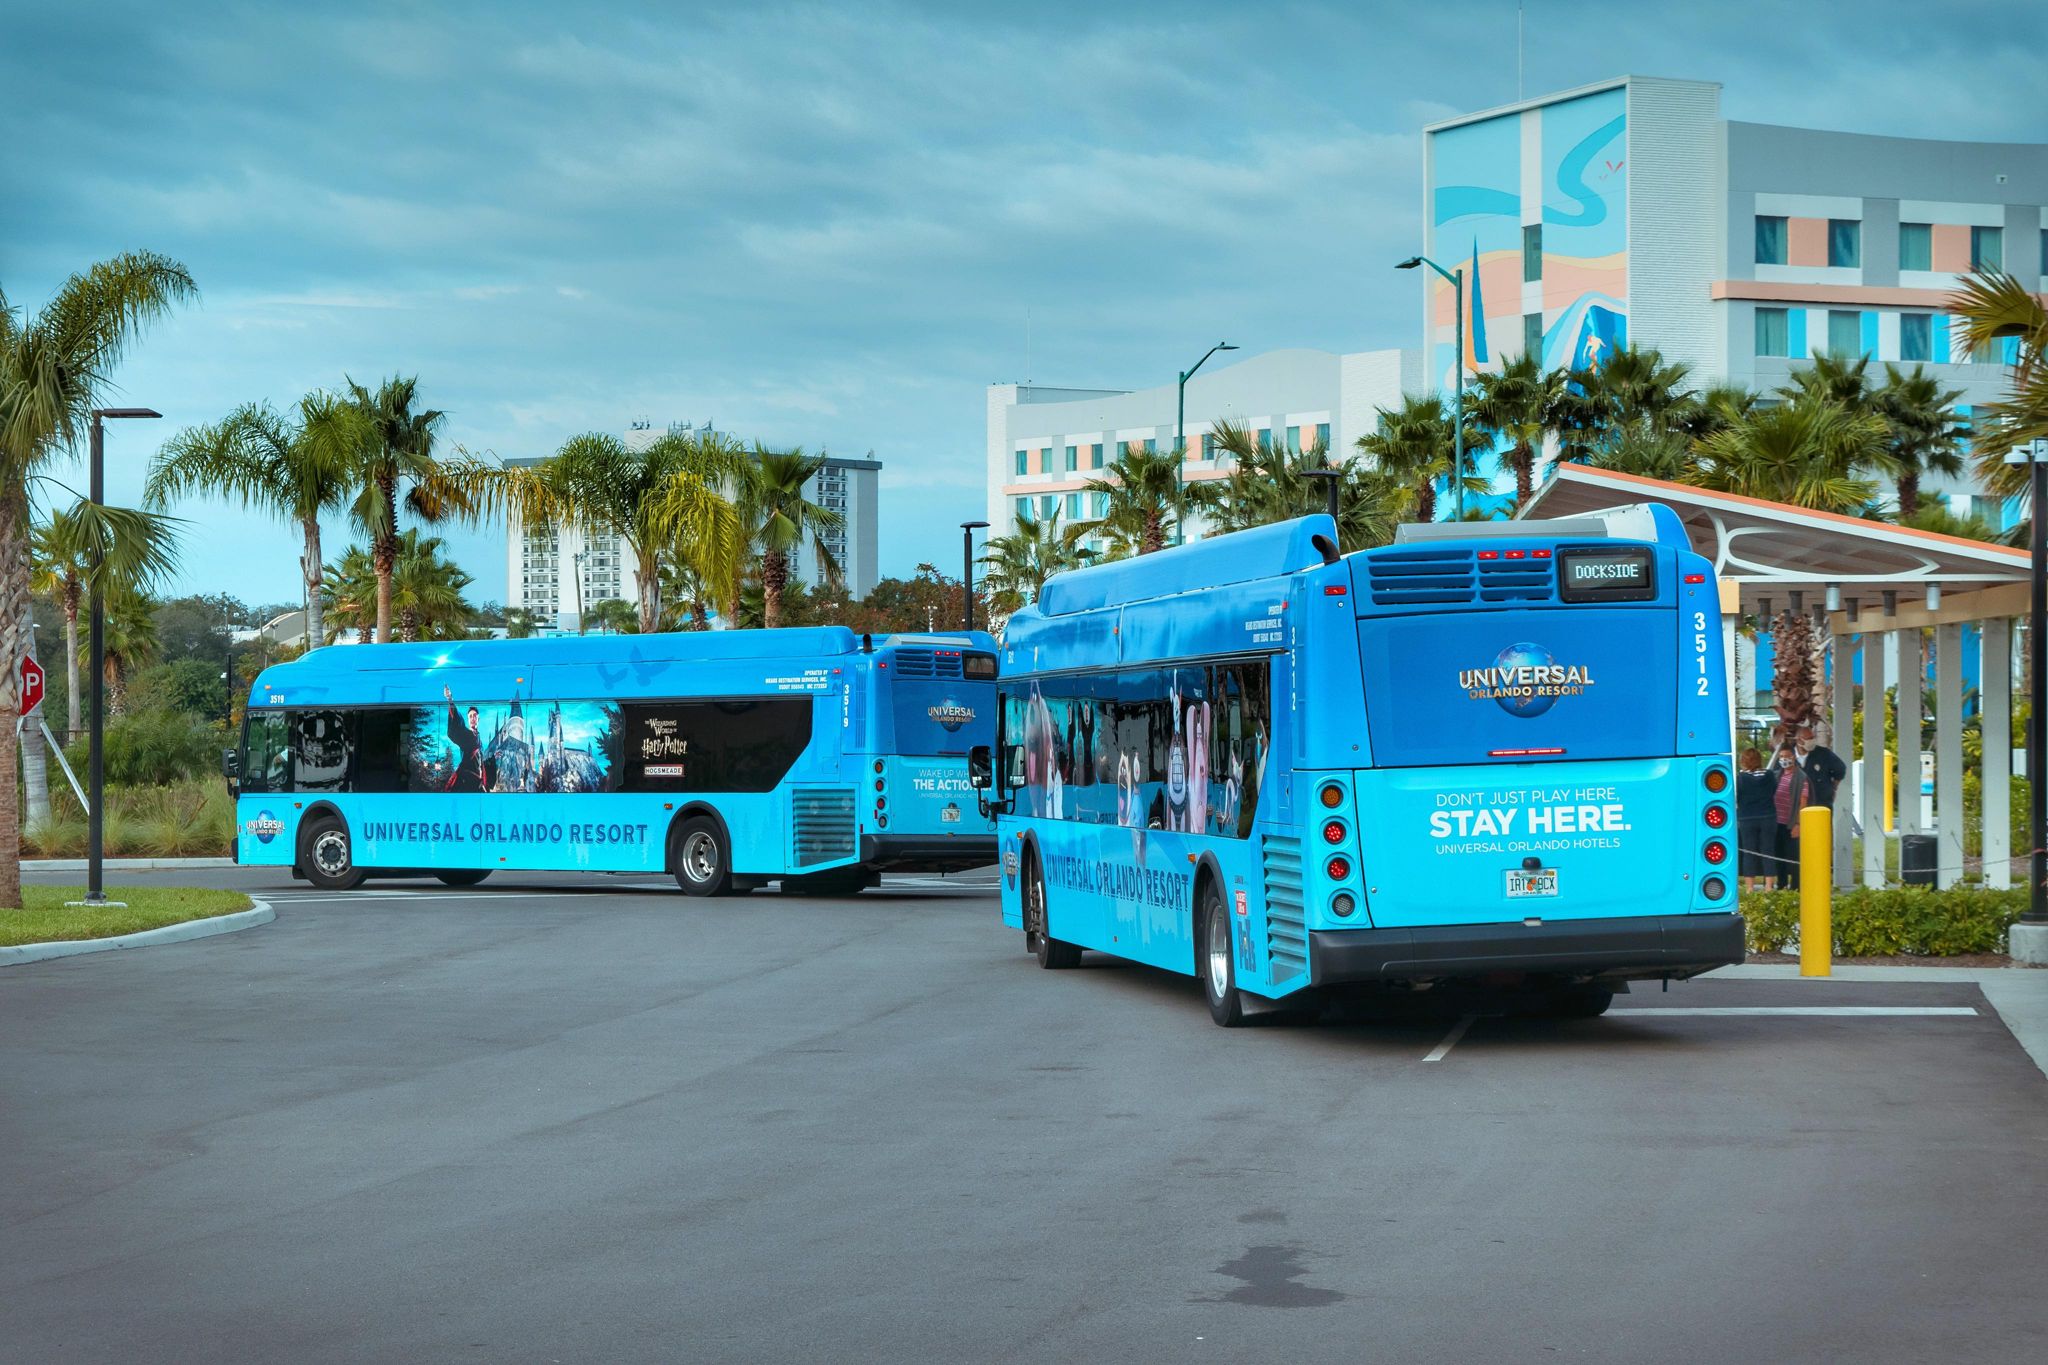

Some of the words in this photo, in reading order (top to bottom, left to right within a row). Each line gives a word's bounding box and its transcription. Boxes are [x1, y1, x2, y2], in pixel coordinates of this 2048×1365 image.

[1575, 564, 1639, 579] DOCKSIDE
[1694, 612, 1709, 696] 3512
[1459, 665, 1595, 690] UNIVERSAL
[270, 694, 285, 704] 3519
[1469, 686, 1533, 700] ORLANDO
[1537, 685, 1585, 697] RESORT
[927, 706, 977, 718] UNIVERSAL
[919, 769, 942, 778] WAKE
[943, 770, 954, 778] UP
[913, 778, 935, 791] THE
[1436, 792, 1485, 807] DON'T
[1489, 790, 1526, 805] JUST
[1531, 789, 1570, 803] PLAY
[1575, 787, 1620, 802] HERE,
[246, 819, 286, 830] UNIVERSAL
[1429, 808, 1518, 838] STAY
[1528, 804, 1632, 834] HERE.
[364, 822, 464, 843] UNIVERSAL
[469, 823, 562, 843] ORLANDO
[569, 823, 648, 845] RESORT
[1435, 842, 1505, 855] UNIVERSAL
[1508, 839, 1570, 852] ORLANDO
[1573, 837, 1621, 849] HOTELS
[1046, 854, 1094, 893] UNIVERSAL
[1096, 860, 1144, 904] ORLANDO
[1146, 868, 1189, 912] RESORT
